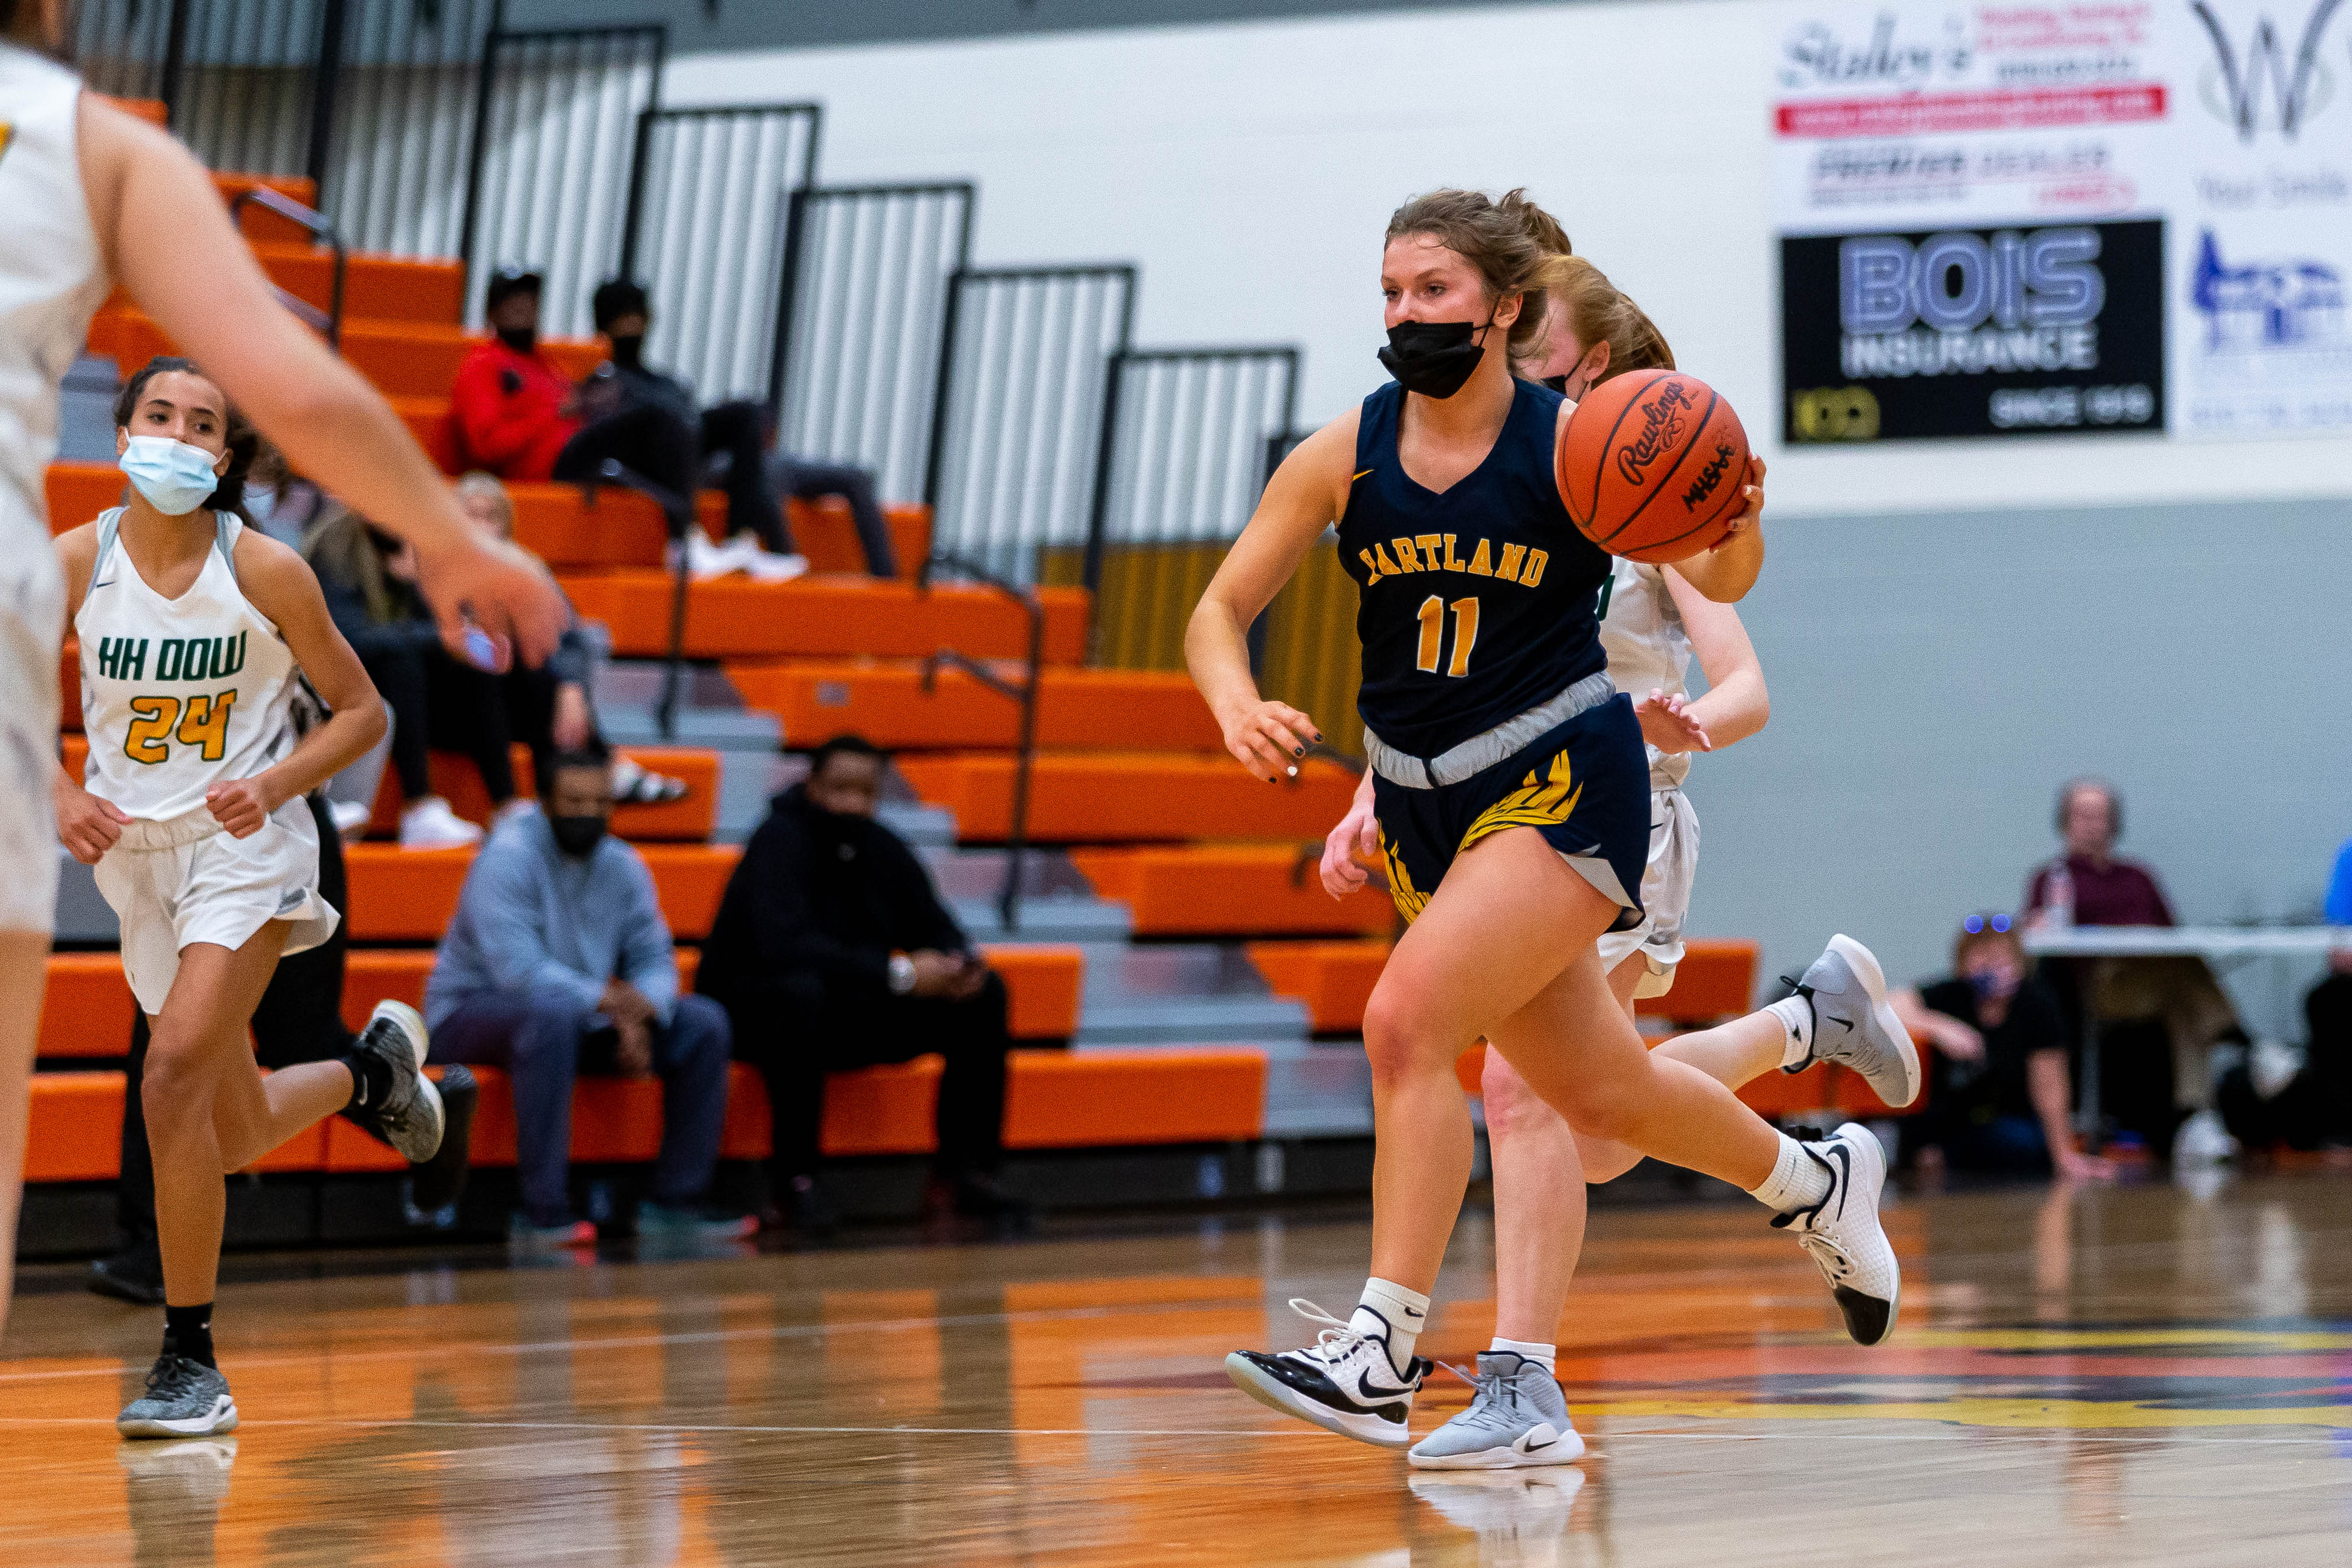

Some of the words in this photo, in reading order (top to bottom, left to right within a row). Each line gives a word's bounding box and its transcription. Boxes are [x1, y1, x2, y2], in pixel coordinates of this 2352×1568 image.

[1839, 226, 2106, 334] BOIS
[1841, 325, 2099, 378] INSURANCE
[99, 637, 149, 680] HH
[155, 630, 247, 681] DOW
[1417, 595, 1478, 677] 11
[123, 689, 237, 764] 24
